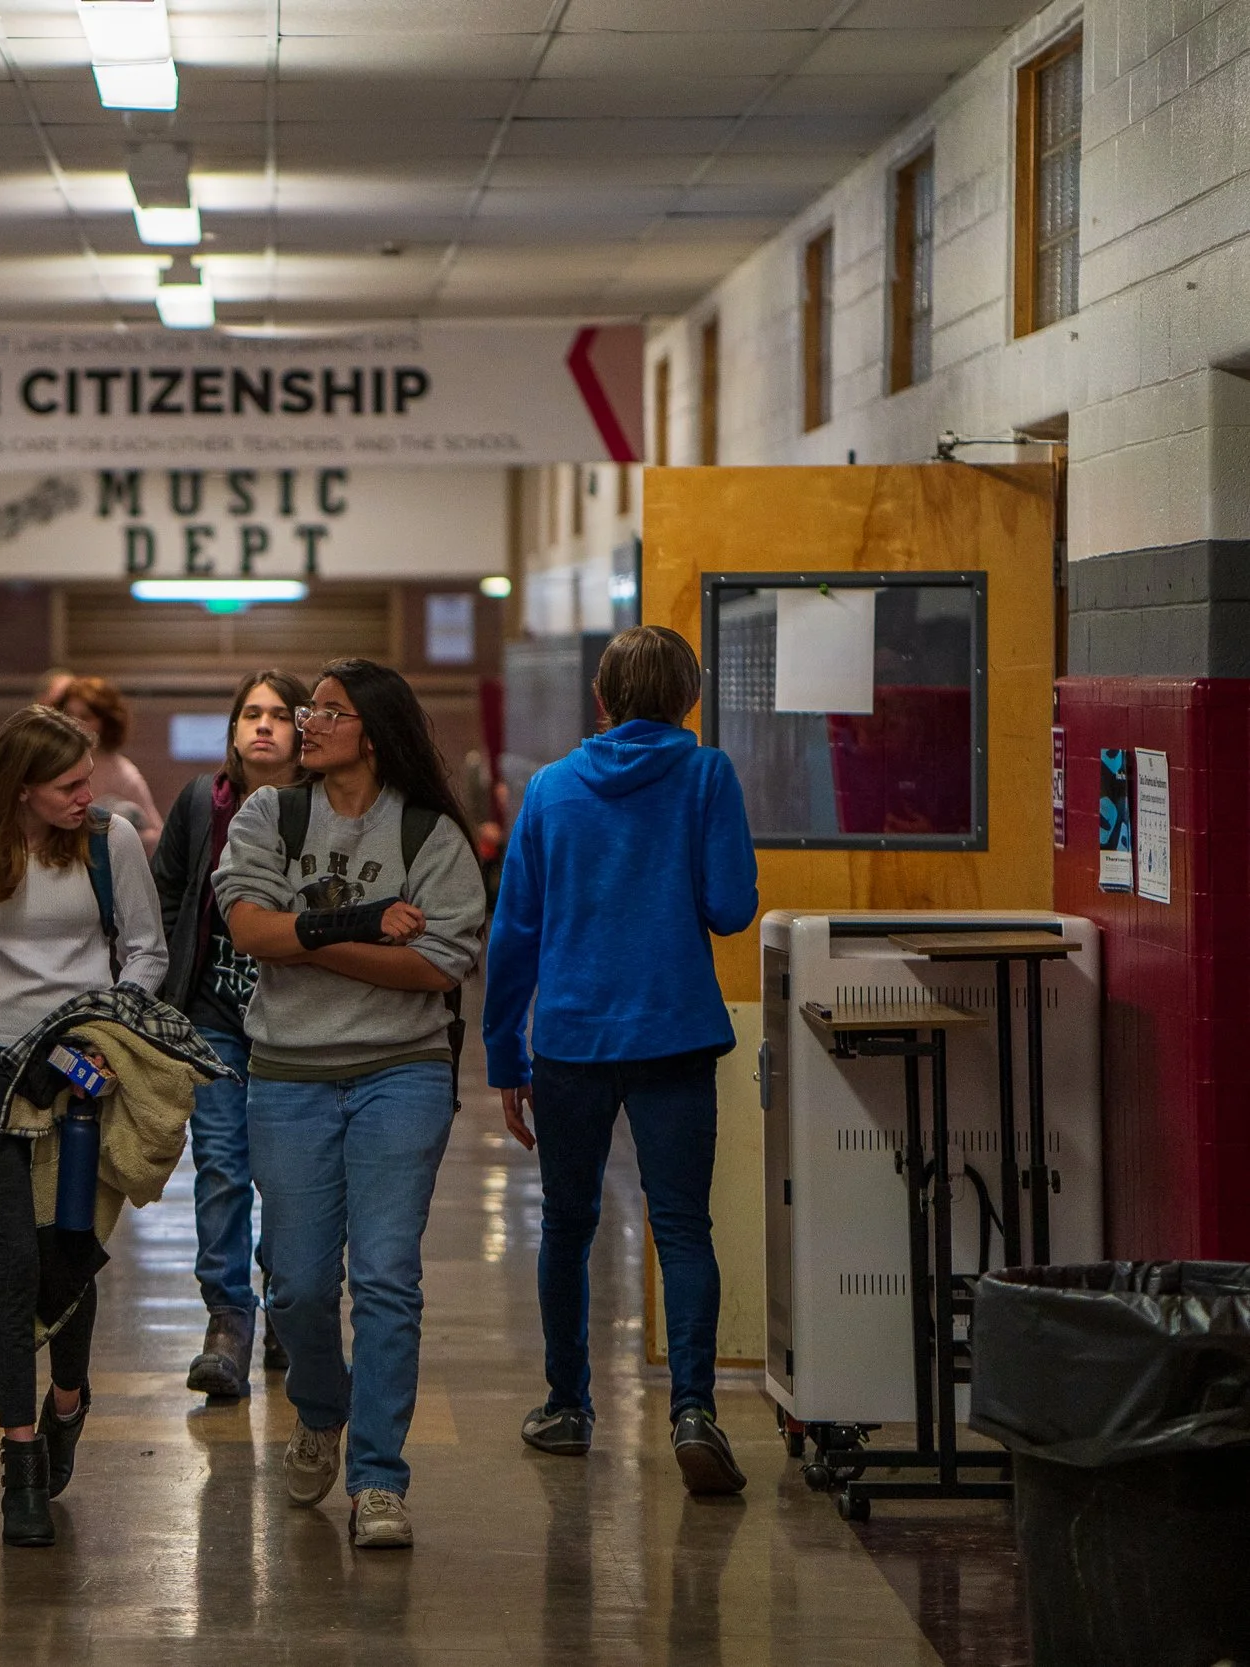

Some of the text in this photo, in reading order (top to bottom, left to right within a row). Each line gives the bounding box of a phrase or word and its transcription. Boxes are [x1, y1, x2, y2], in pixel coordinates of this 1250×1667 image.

[20, 366, 430, 416] CITIZENSHIP
[97, 467, 348, 518] MUSIC
[124, 524, 329, 576] DEPT
